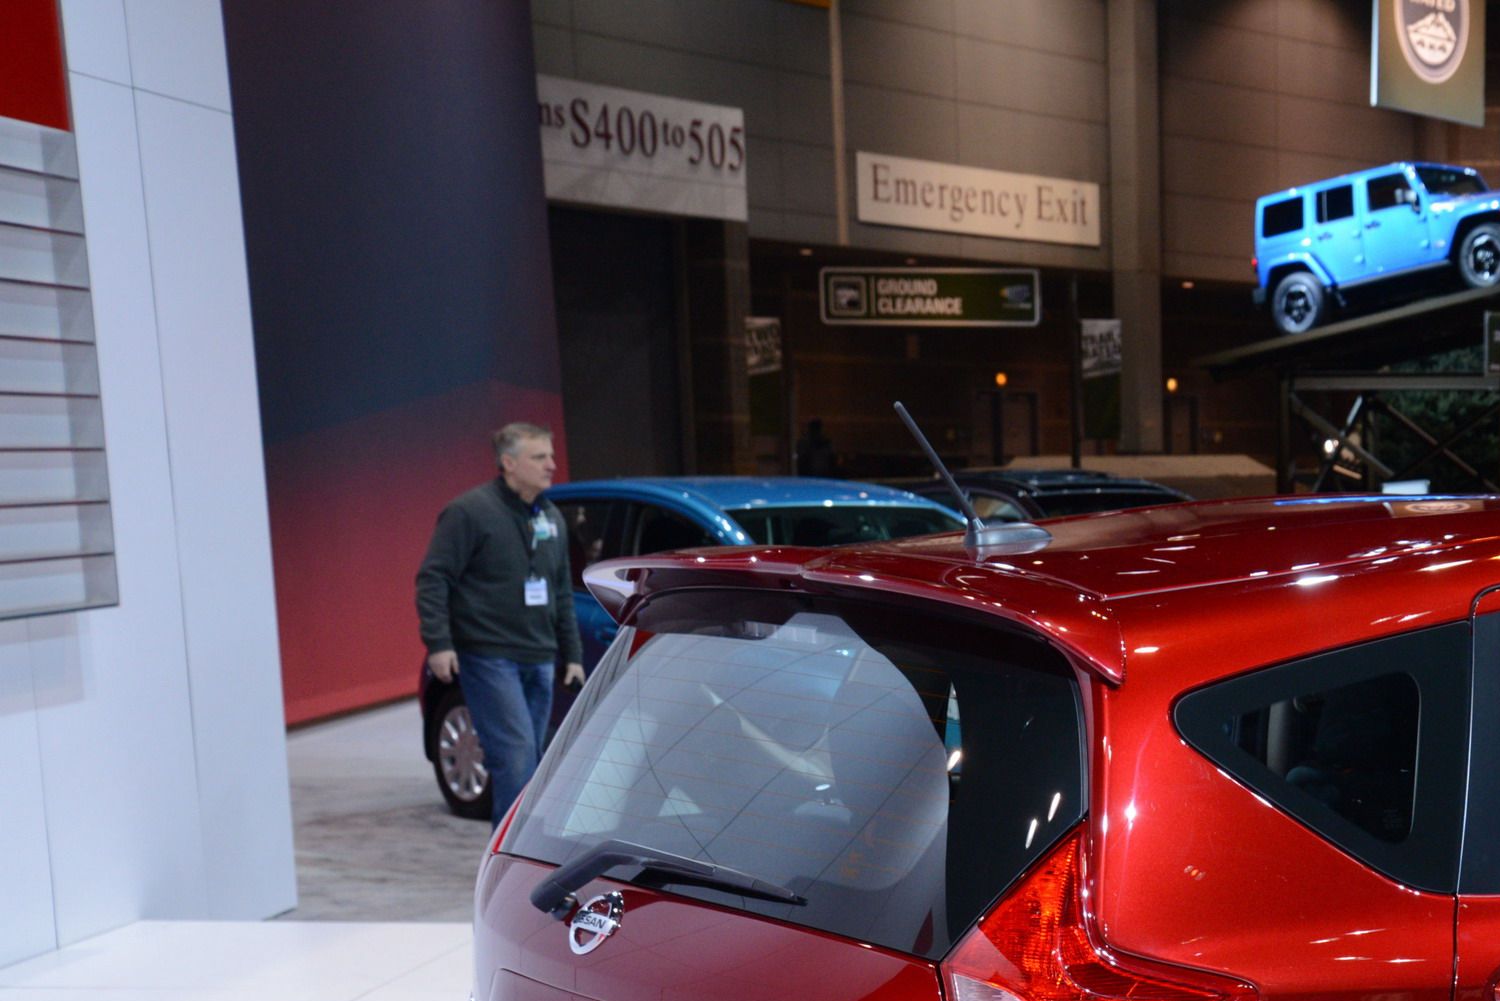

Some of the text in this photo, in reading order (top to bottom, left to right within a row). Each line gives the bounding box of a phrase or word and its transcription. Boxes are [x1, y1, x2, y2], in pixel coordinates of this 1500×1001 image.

[570, 98, 658, 158] S400
[662, 118, 685, 148] to
[689, 119, 744, 172] 505
[871, 162, 1088, 229] Emergency Exit
[876, 277, 938, 296] GROUND
[877, 297, 963, 315] CLEARANCE
